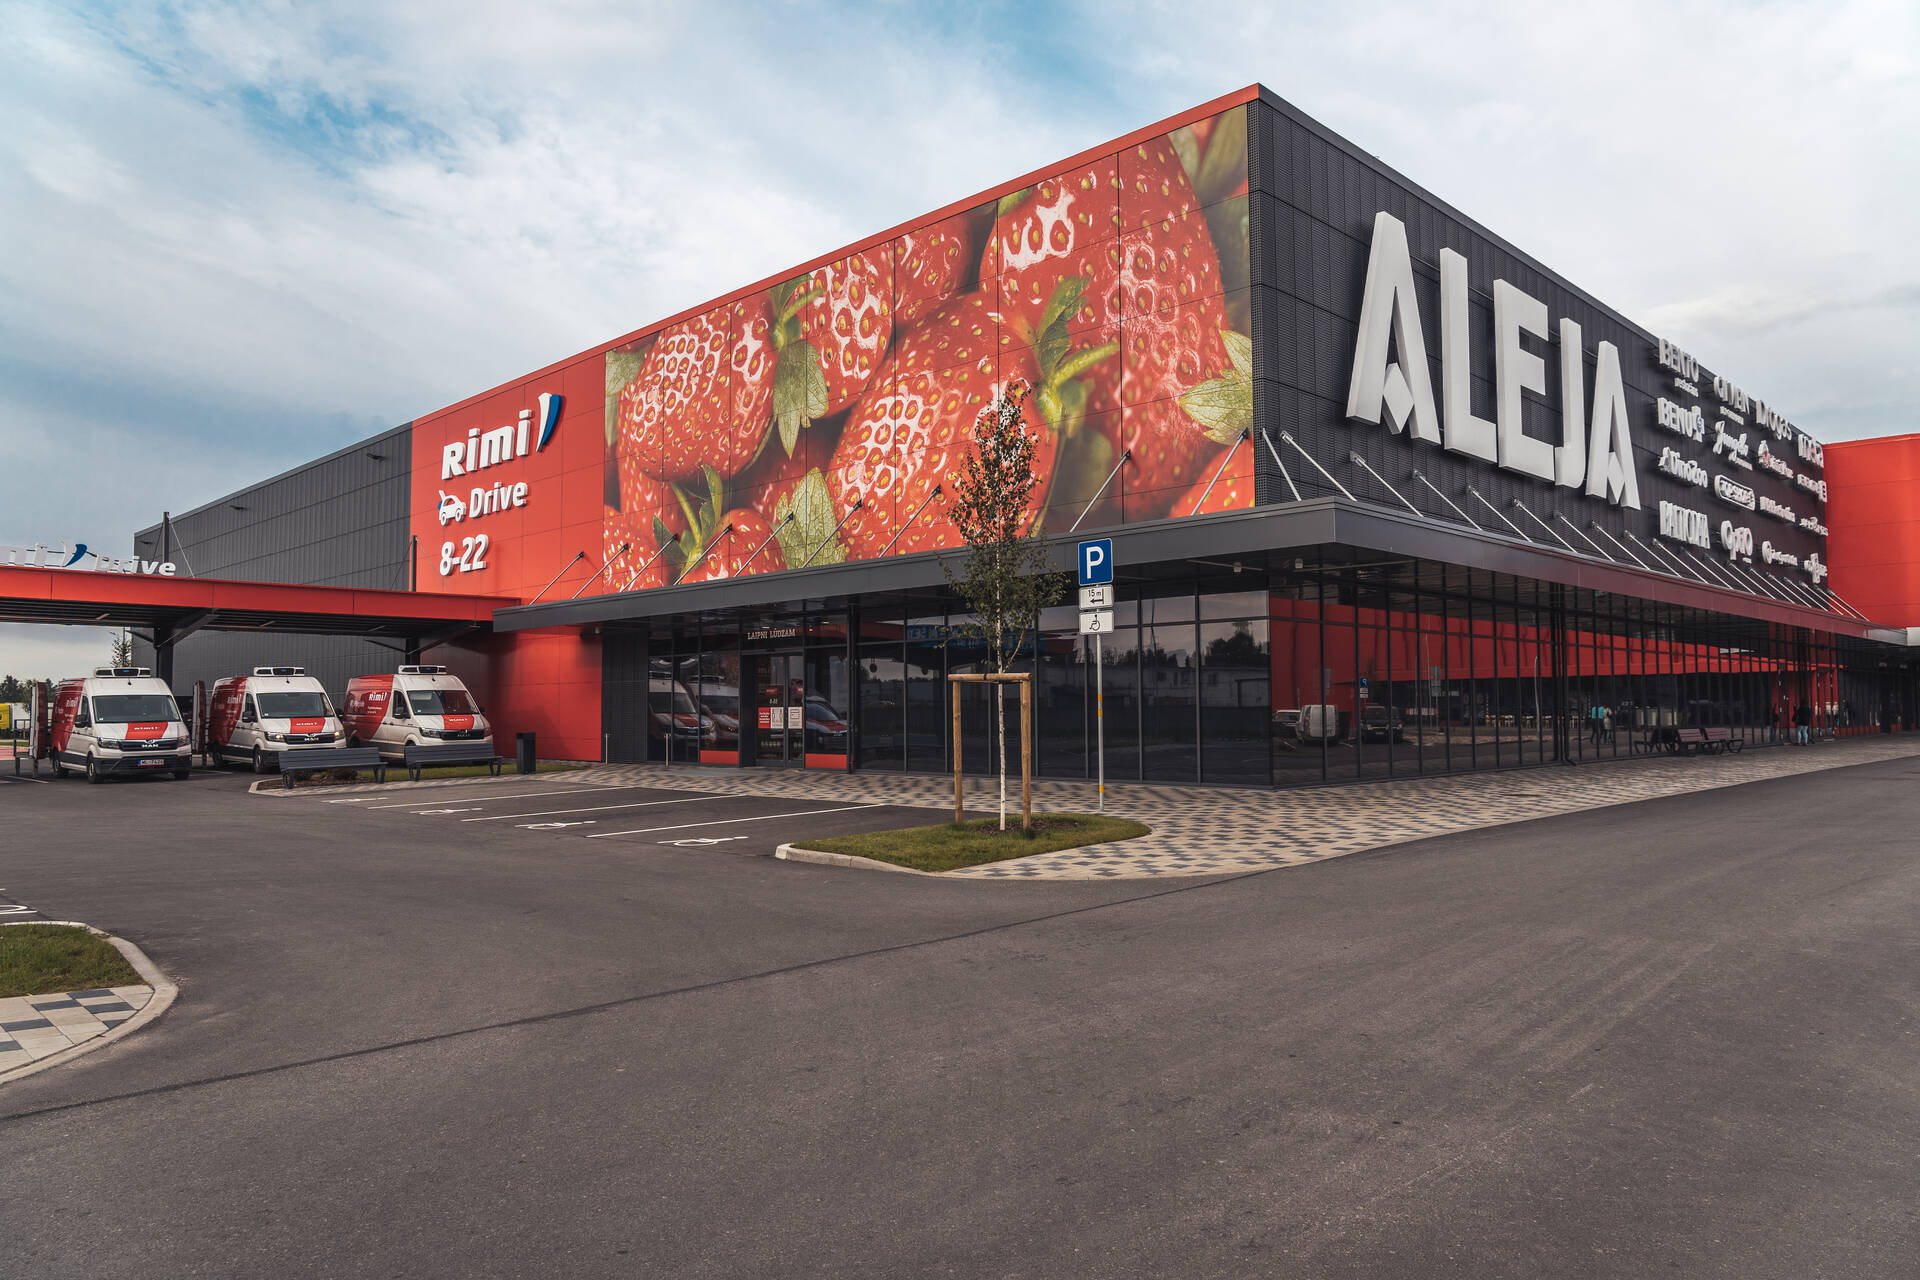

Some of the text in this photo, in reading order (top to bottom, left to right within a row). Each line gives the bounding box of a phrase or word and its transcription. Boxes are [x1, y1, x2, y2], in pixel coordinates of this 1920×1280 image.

[1346, 210, 1641, 510] ALEJA
[1659, 338, 1699, 382] BENTO
[1756, 399, 1792, 440] Drogas
[441, 408, 533, 480] Rimi
[469, 481, 528, 518] Drive
[439, 533, 490, 576] 8-22
[1086, 546, 1104, 579] P
[1088, 589, 1095, 598] 15
[747, 631, 768, 640] LAIPNI
[368, 692, 384, 701] Rimi
